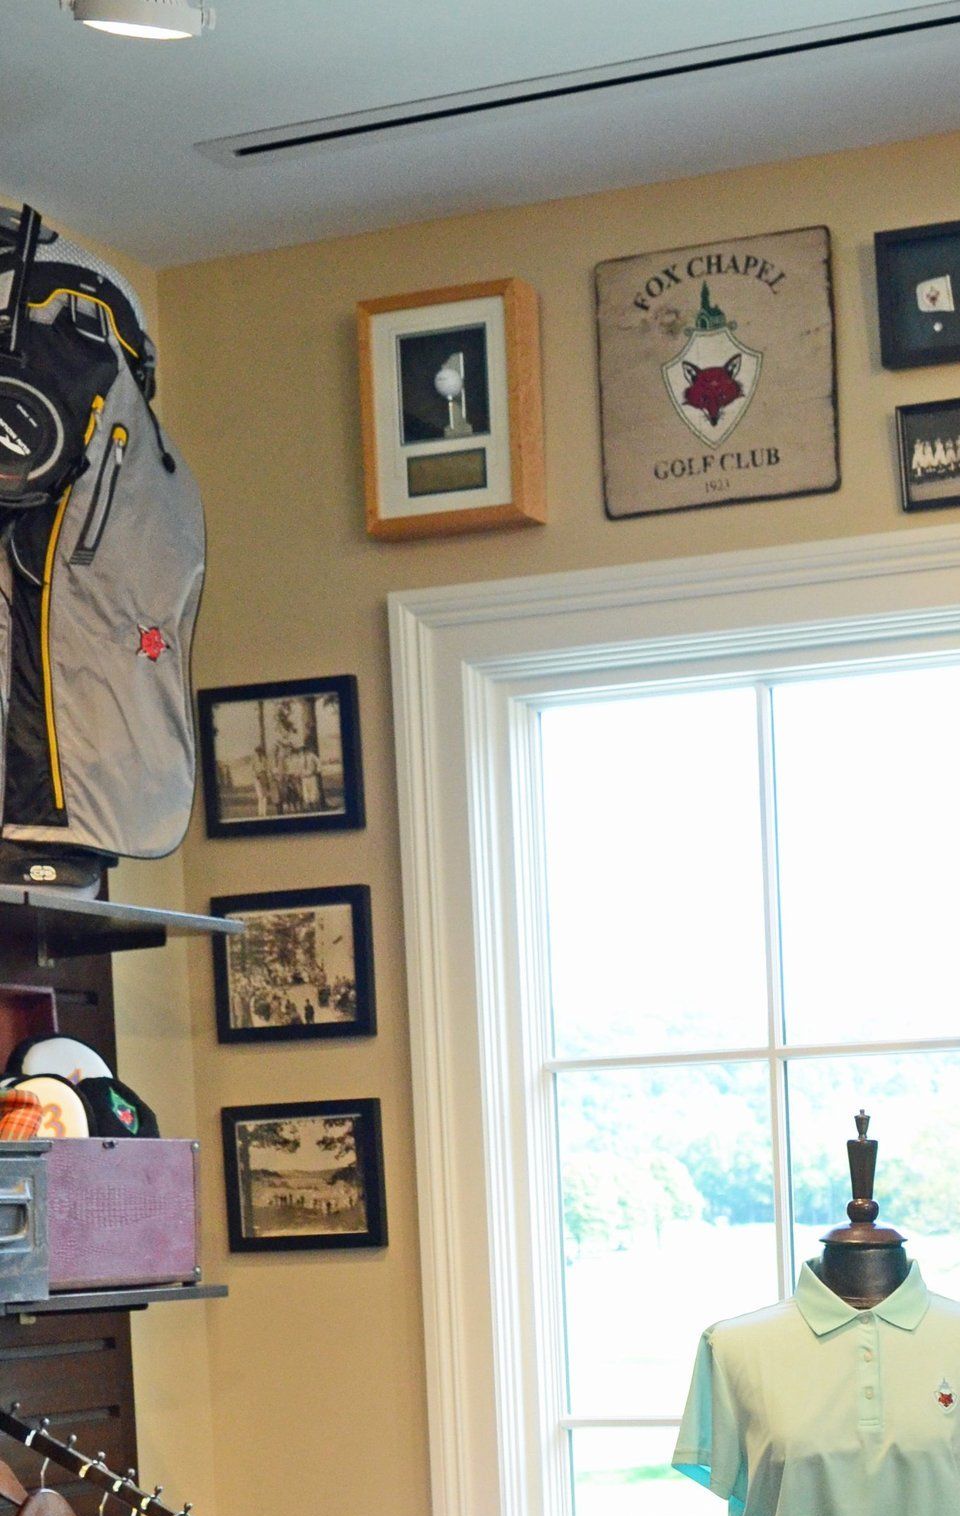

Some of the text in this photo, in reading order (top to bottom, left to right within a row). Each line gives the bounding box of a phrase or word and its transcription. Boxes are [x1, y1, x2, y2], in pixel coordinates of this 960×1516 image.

[633, 253, 786, 312] FOX CHAPEL
[653, 446, 781, 481] GOLF CLUB
